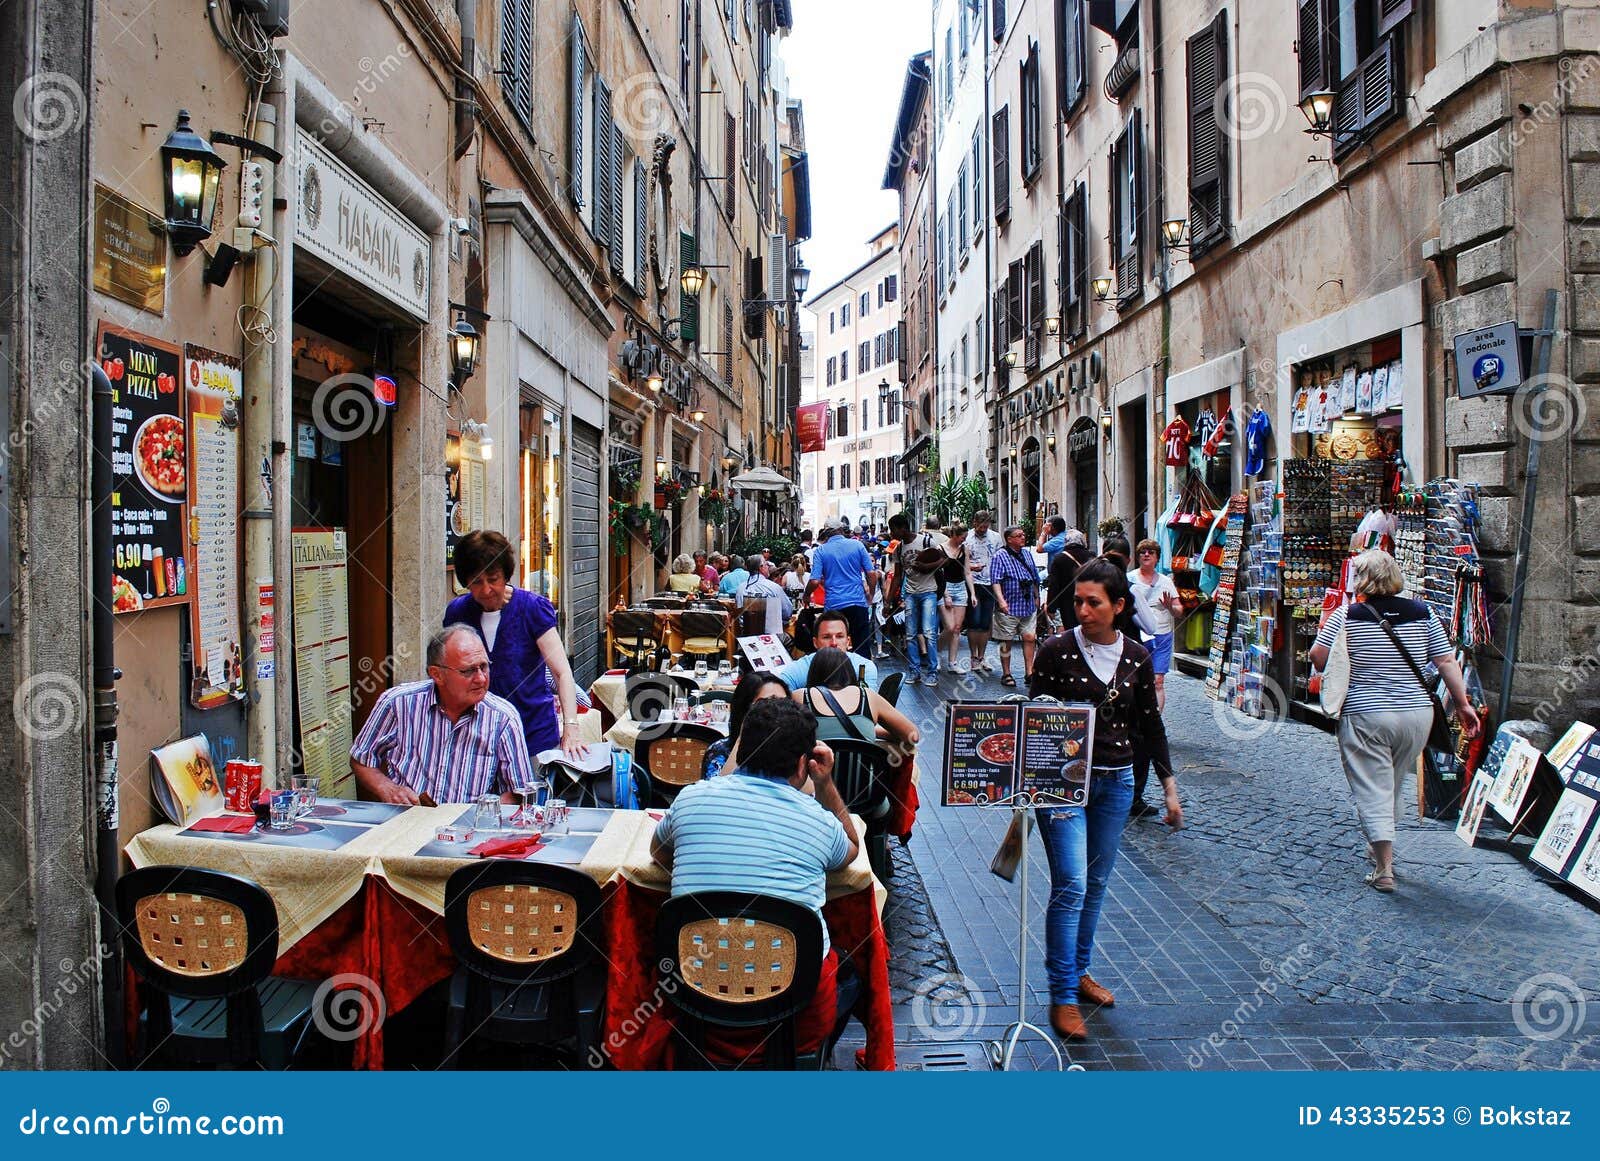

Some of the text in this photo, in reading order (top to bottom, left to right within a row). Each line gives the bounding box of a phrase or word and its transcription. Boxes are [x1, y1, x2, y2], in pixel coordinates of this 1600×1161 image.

[338, 190, 401, 284] HABANA
[1475, 332, 1494, 342] area
[1465, 339, 1506, 356] pedonale
[128, 348, 158, 376] MENÙ
[127, 373, 158, 400] PIZZA
[1166, 437, 1180, 459] 10
[124, 508, 137, 520] Coca
[138, 508, 149, 520] cola
[123, 523, 136, 535] Vino
[116, 543, 141, 570] 6,90
[295, 545, 327, 562] ITALIAN
[972, 721, 996, 729] PIZZA
[1043, 723, 1070, 731] PASTA
